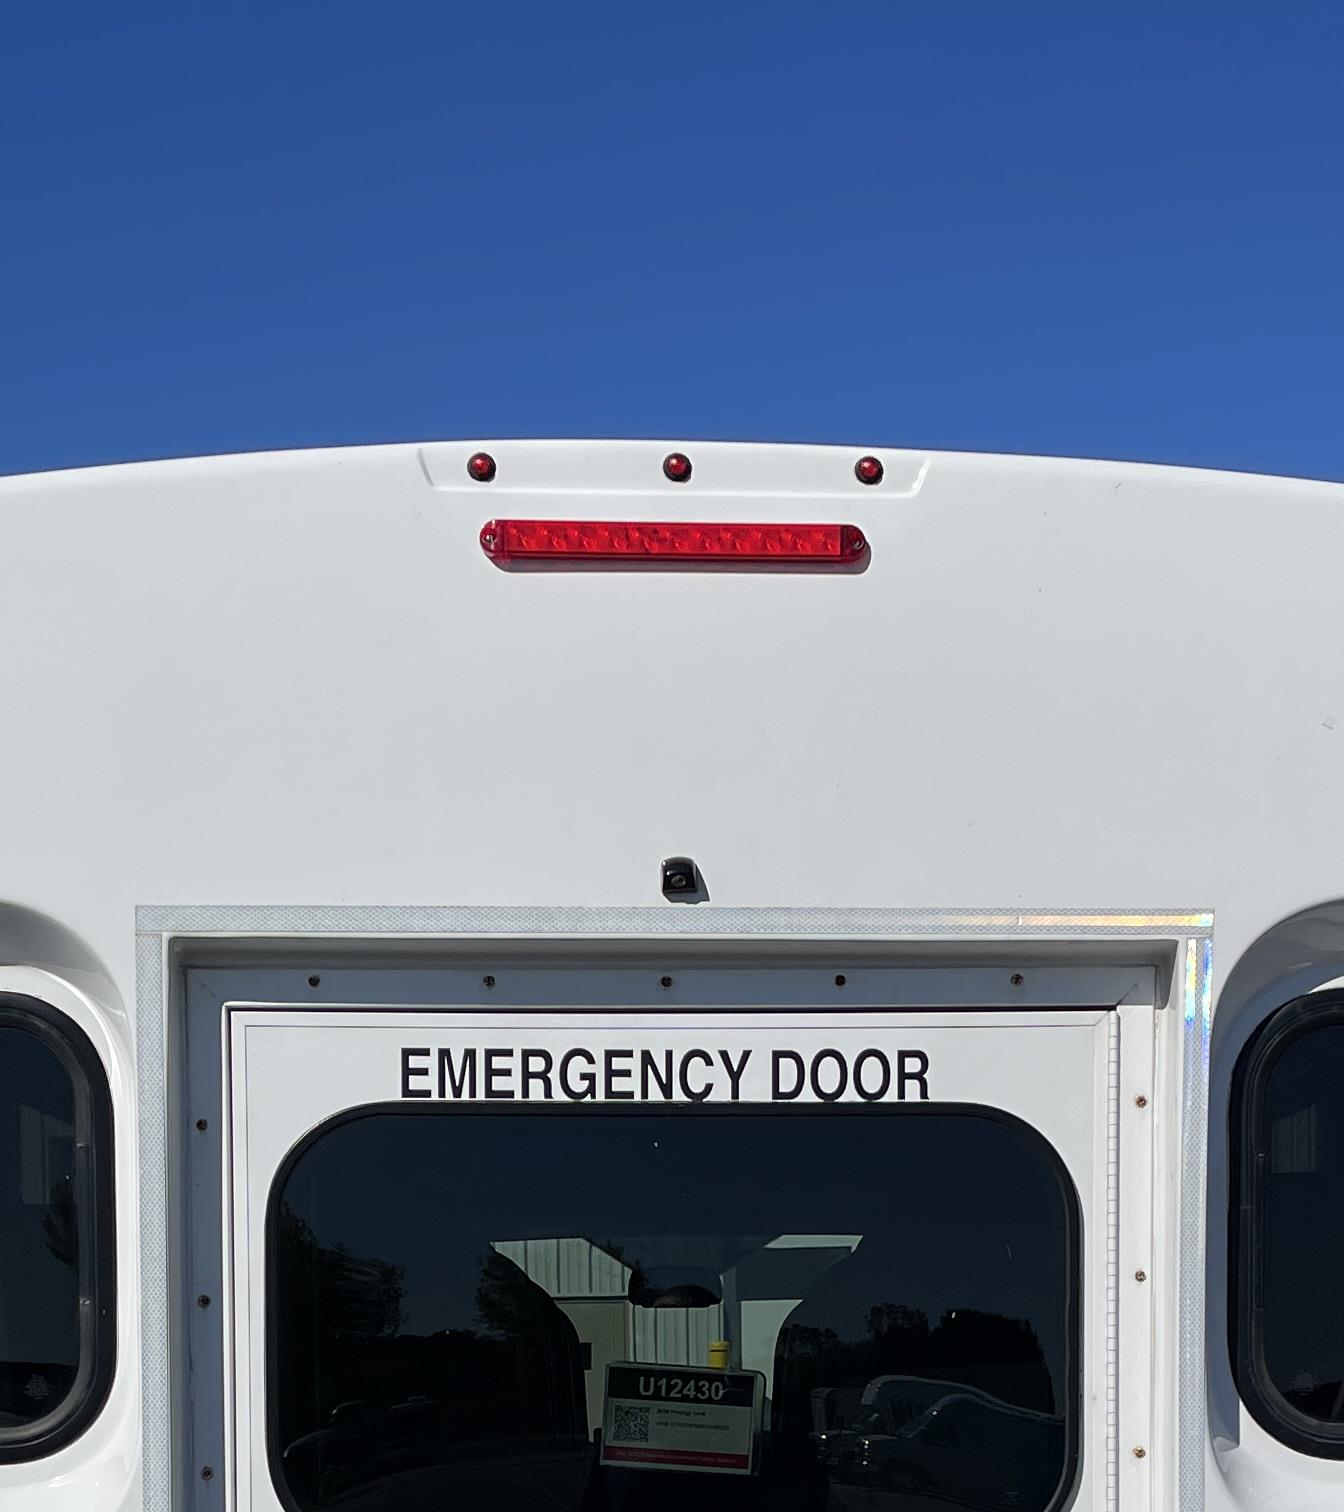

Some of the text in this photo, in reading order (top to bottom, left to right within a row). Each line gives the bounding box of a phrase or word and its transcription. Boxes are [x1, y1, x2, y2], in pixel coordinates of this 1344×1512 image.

[400, 1047, 931, 1101] EMERGENCY DOOR
[639, 1376, 725, 1401] U12430
